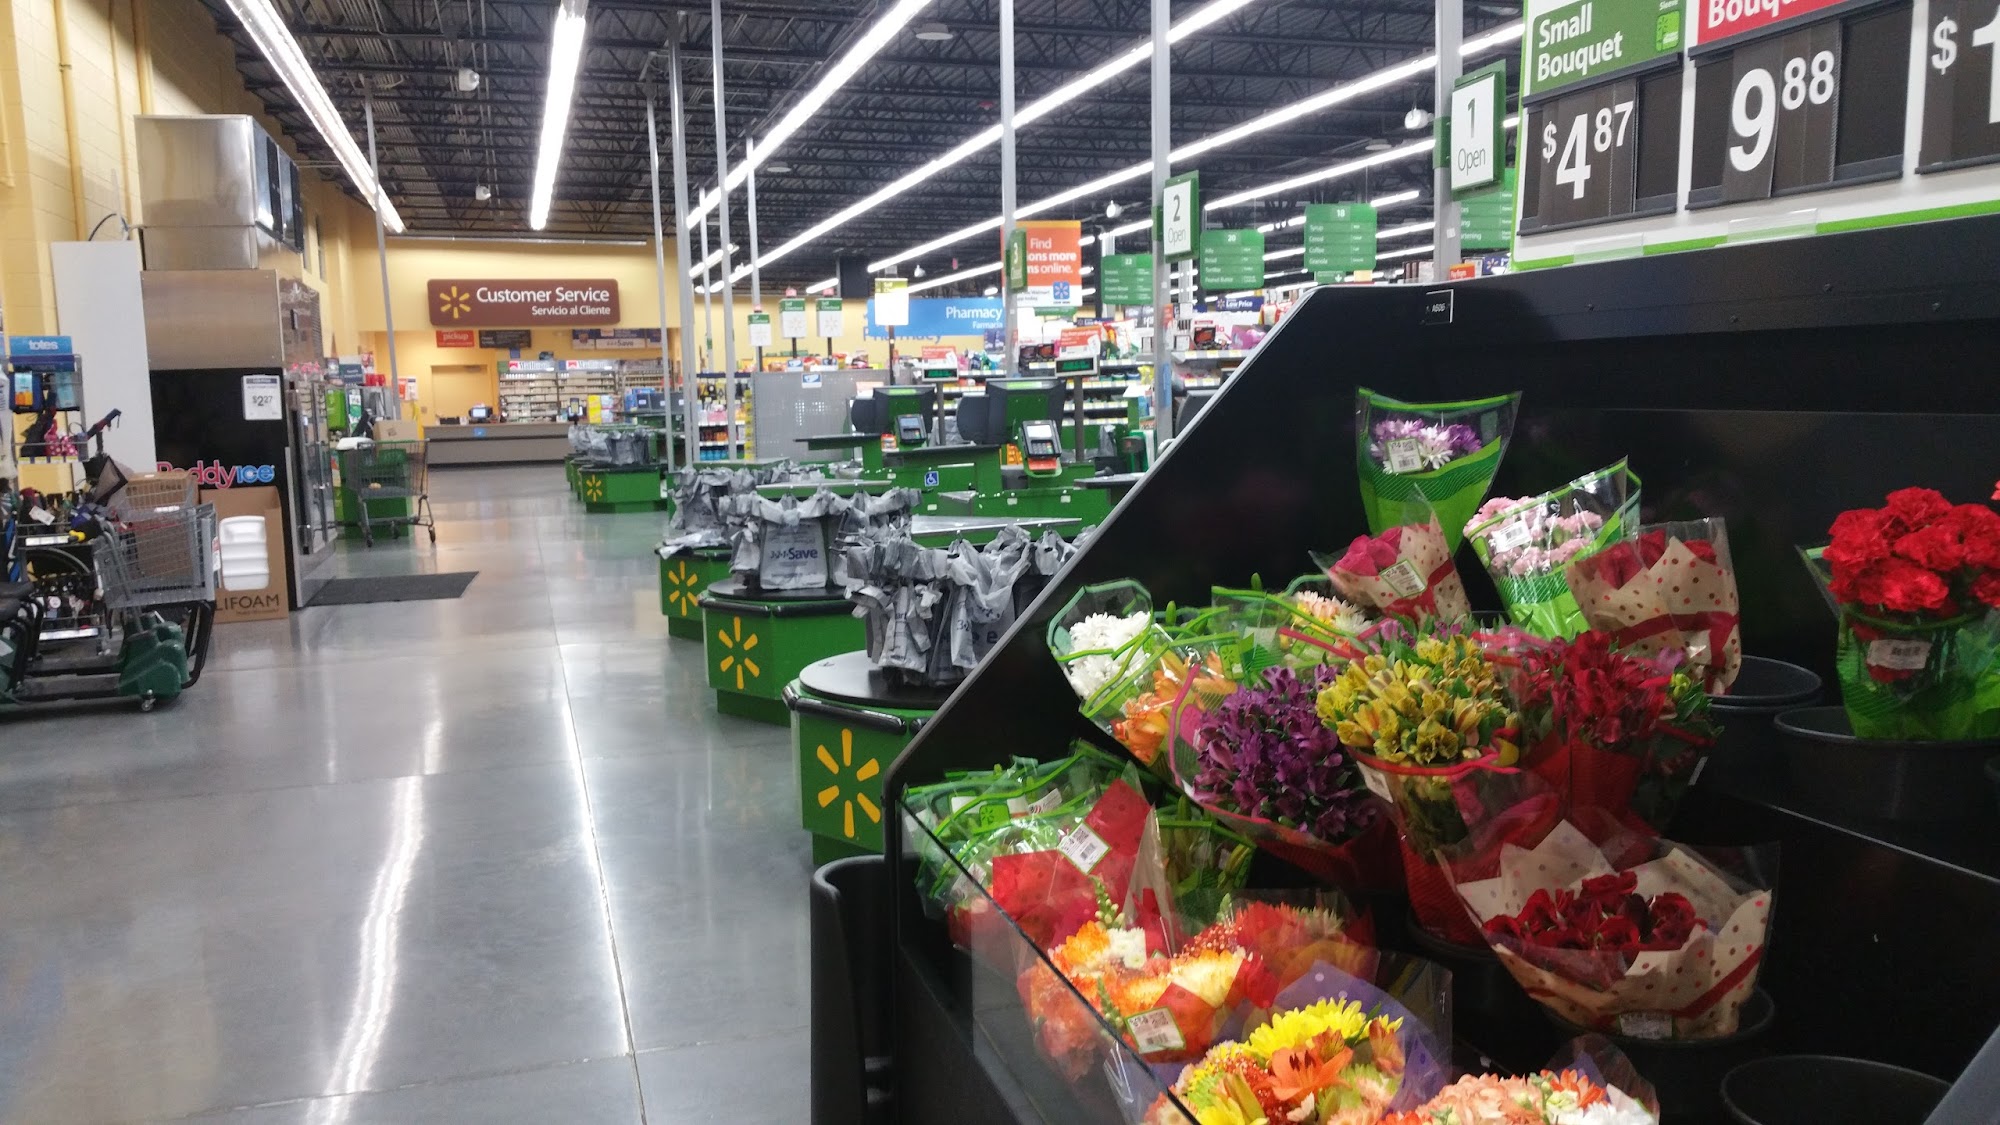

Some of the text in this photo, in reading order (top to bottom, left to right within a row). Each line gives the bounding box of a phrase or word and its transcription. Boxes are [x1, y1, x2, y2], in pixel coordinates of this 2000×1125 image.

[1539, 2, 1592, 48] Small
[1537, 31, 1623, 82] Bouquet
[1468, 97, 1476, 138] 1
[1458, 147, 1486, 176] Open
[1173, 194, 1181, 223] 2
[1336, 208, 1346, 218] 18
[1030, 237, 1052, 249] Find
[1168, 227, 1187, 247] Open
[1227, 233, 1237, 242] 20
[1028, 252, 1077, 262] ons more
[1040, 262, 1073, 274] online.
[476, 286, 610, 302] Customer Service
[1239, 300, 1253, 308] Price
[531, 305, 611, 316] Servicio al Cliente
[946, 306, 1003, 320] Pharmacy
[972, 321, 1004, 330] Farmacia
[28, 339, 58, 350] totes
